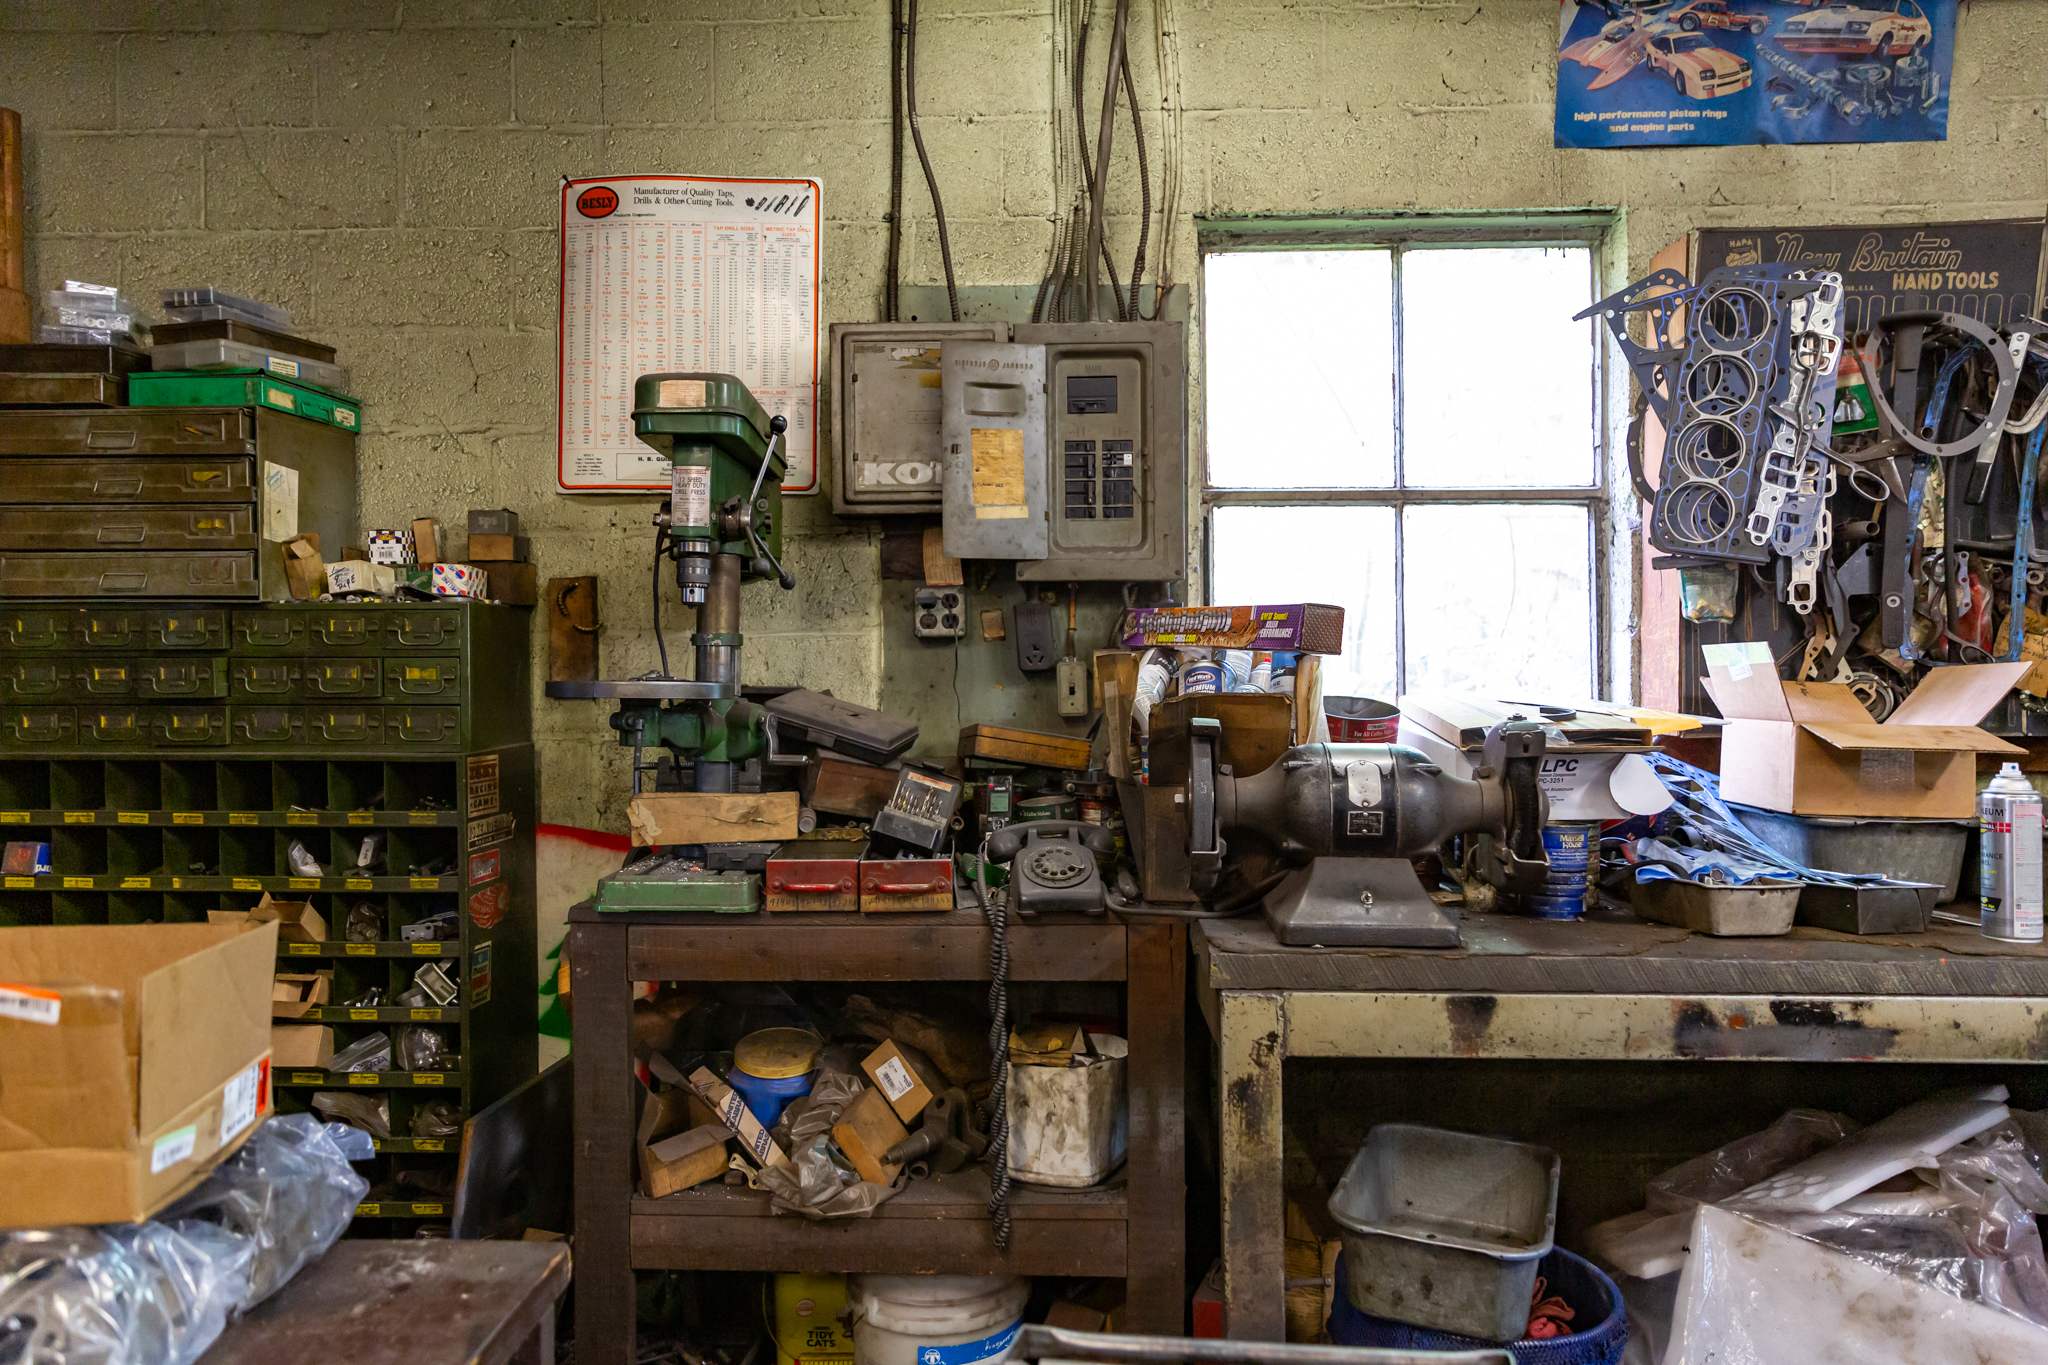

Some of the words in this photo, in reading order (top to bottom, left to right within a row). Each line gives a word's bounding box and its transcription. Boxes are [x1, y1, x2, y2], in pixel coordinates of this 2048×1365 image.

[1574, 112, 1597, 122] high
[1599, 110, 1667, 121] performance
[1669, 109, 1701, 119] piston
[1702, 109, 1728, 119] rings
[1609, 123, 1629, 132] and
[1631, 123, 1665, 133] engine
[1667, 123, 1695, 132] parts
[634, 187, 679, 195] Manufacturer
[689, 188, 714, 197] Quality
[717, 189, 735, 198] Taps,
[581, 197, 614, 209] BESLY
[634, 197, 652, 205] Drills
[663, 197, 684, 205] Other
[686, 198, 712, 207] Cutting
[1849, 232, 1962, 271] Britain
[1892, 272, 1943, 291] HAND
[1946, 271, 1999, 290] TOOLS
[864, 462, 942, 485] KO
[1186, 684, 1216, 693] PREMIUM
[1541, 759, 1579, 772] LPC
[469, 763, 497, 781] ISKY
[469, 783, 497, 796] RACING
[473, 797, 494, 809] CAMS
[1563, 841, 1582, 849] House
[807, 1331, 834, 1339] TIDY
